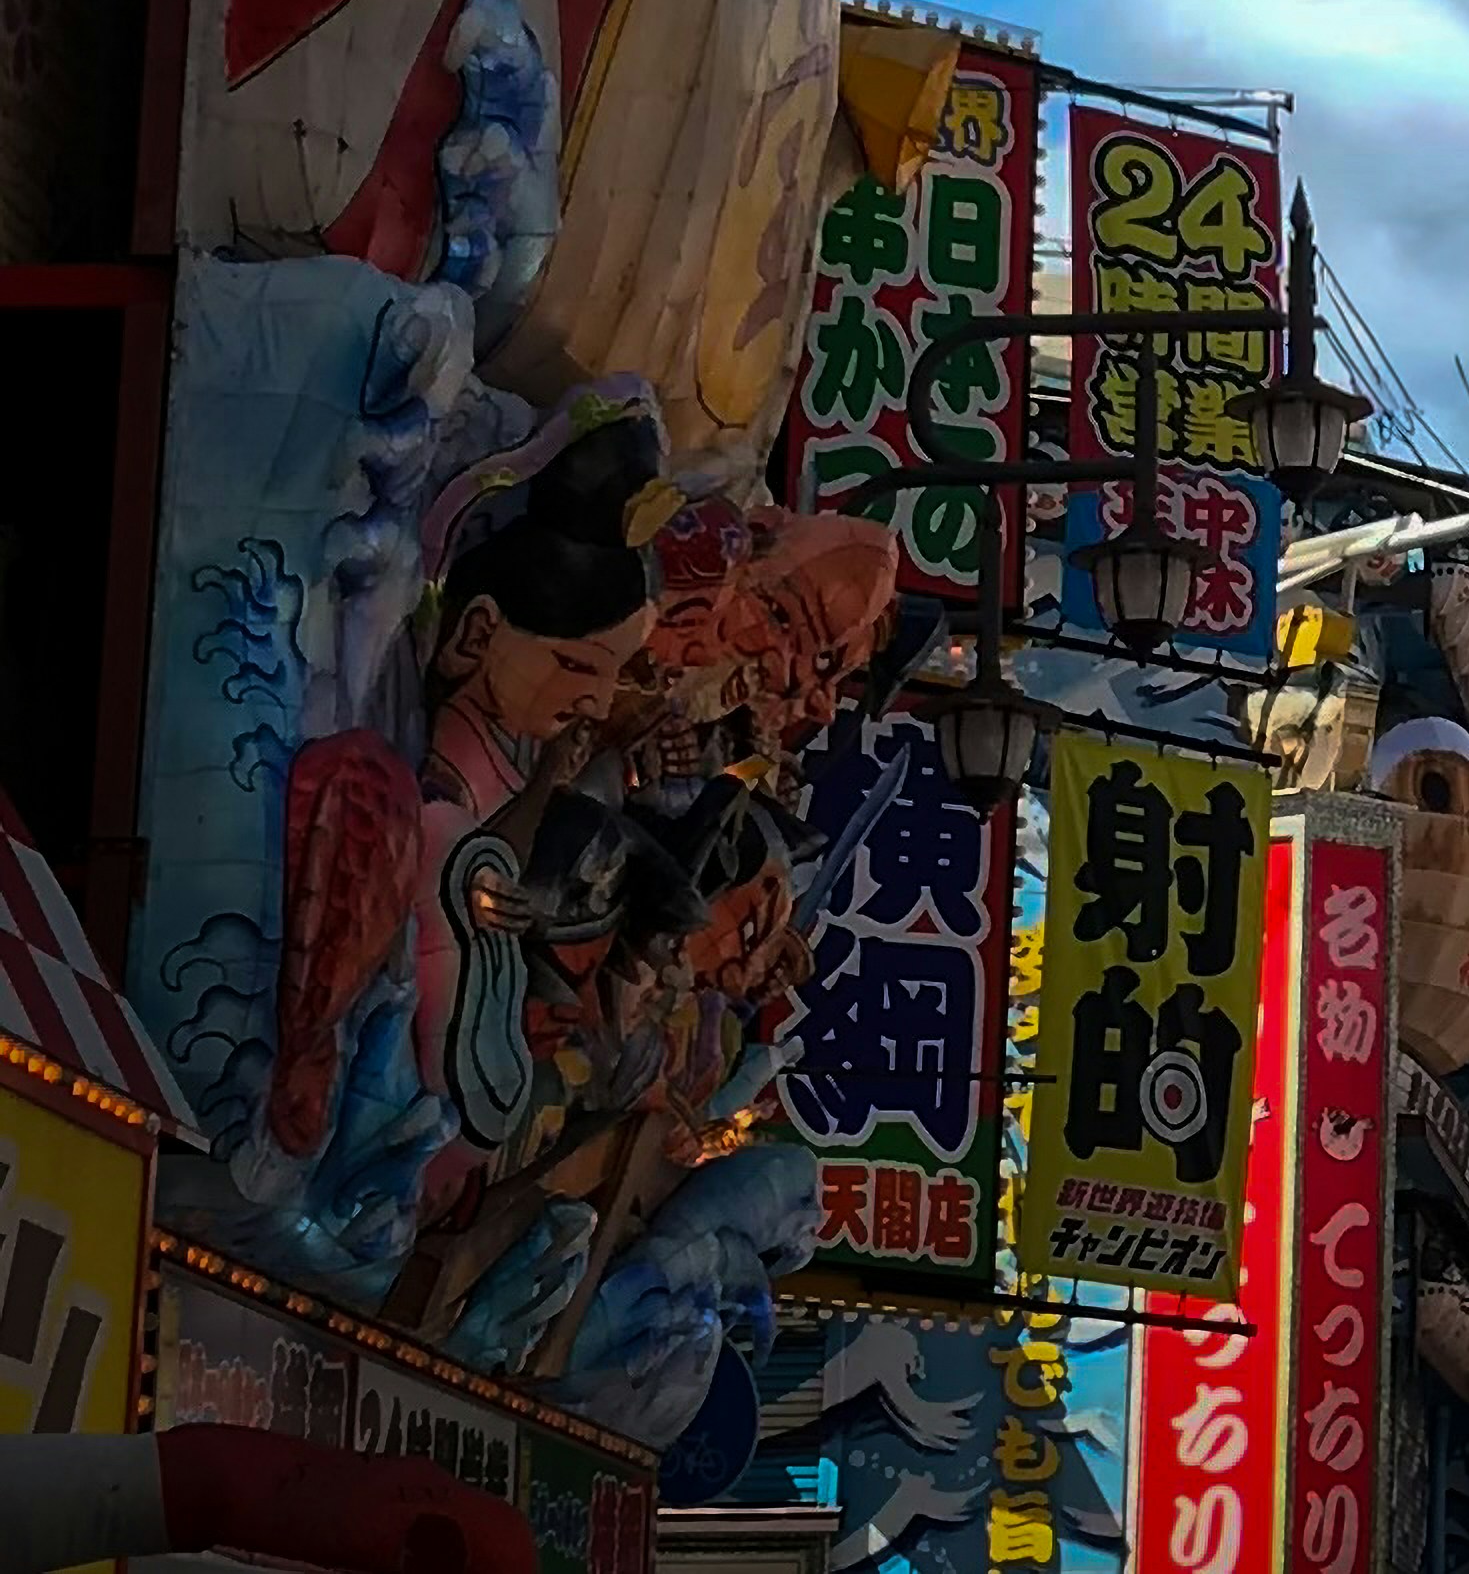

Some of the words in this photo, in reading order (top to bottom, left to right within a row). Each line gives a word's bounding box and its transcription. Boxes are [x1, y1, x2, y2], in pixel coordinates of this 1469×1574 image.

[1094, 262, 1268, 376] 時間
[1096, 138, 1272, 280] 24
[812, 172, 908, 522] 串かつ
[914, 172, 1006, 574] 日本一の
[1098, 369, 1264, 468] 営業
[786, 706, 983, 1150] 横綱
[1066, 760, 1256, 1182] 射的
[1316, 883, 1381, 1064] 名物
[816, 1162, 978, 1261] 天閣店
[1049, 1217, 1227, 1280] チャンピオン
[990, 1272, 1065, 1574] でも旨
[1170, 1303, 1250, 1574] っちり
[1302, 1201, 1372, 1574] てっちり
